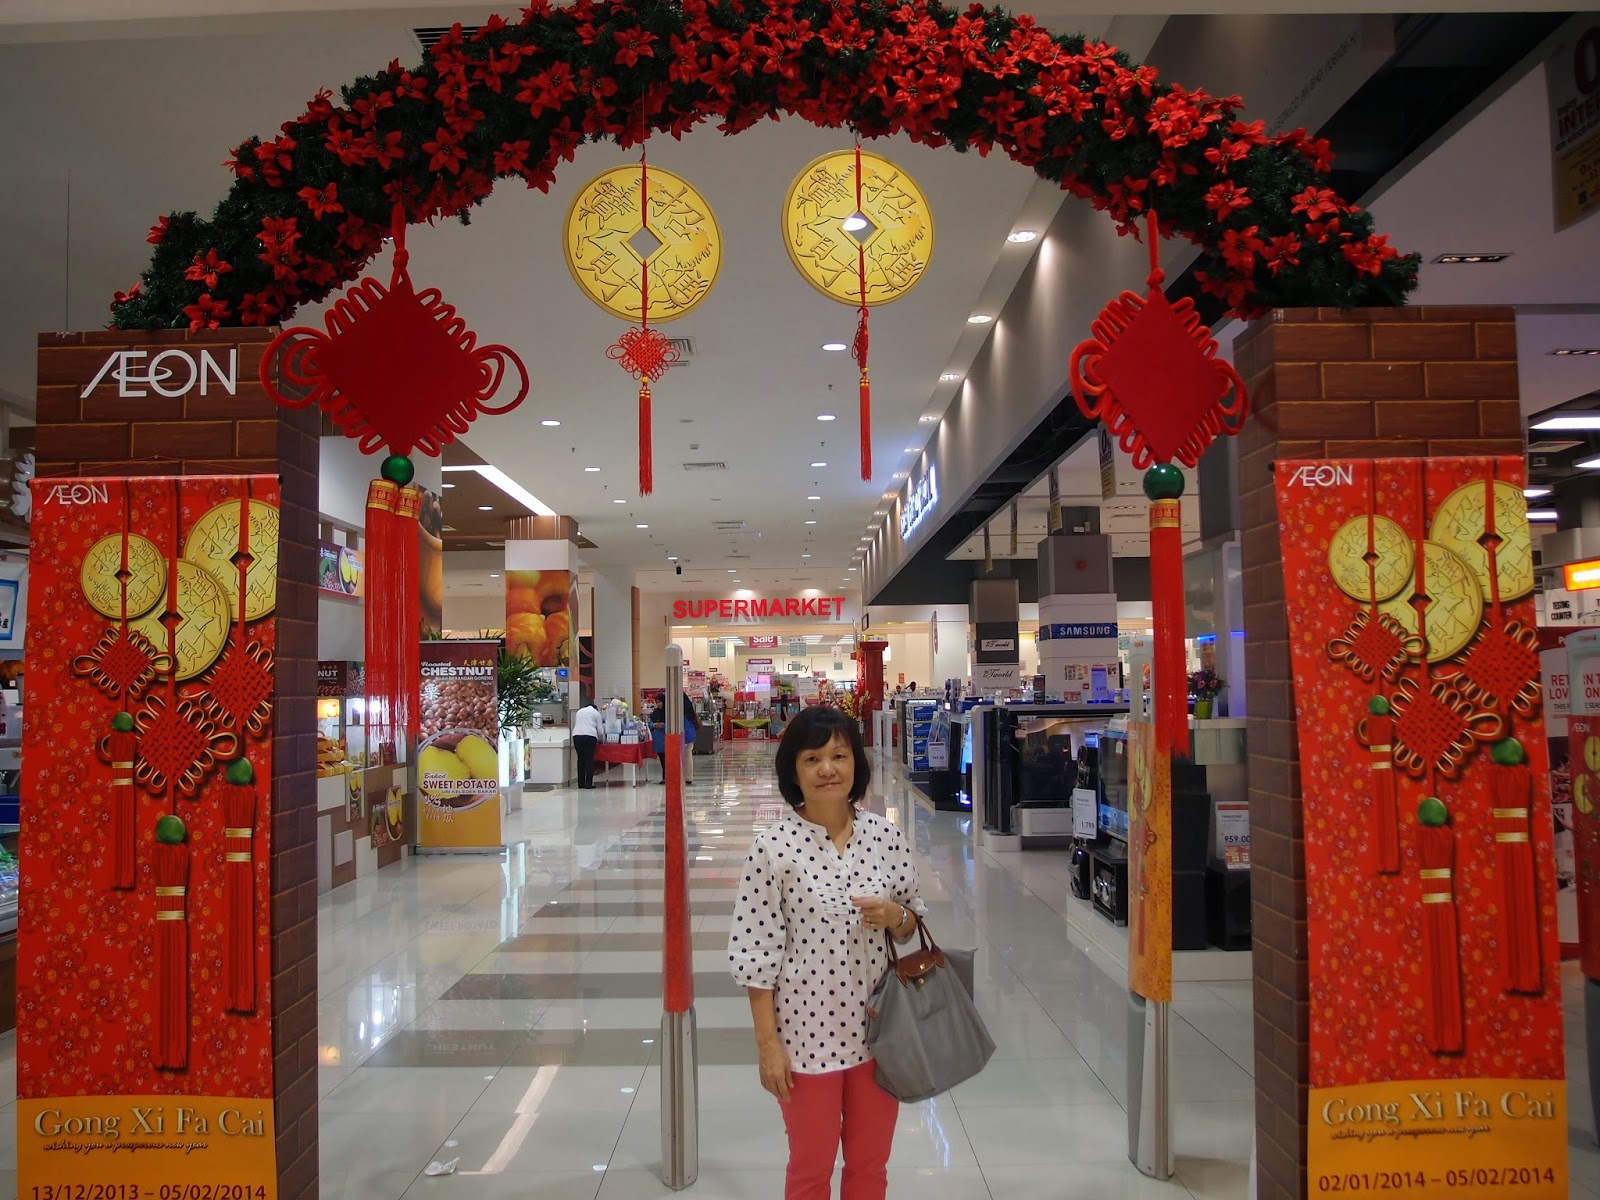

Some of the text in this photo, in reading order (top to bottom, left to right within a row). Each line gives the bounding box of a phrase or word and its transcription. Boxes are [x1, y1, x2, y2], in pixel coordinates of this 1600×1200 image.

[672, 597, 846, 619] SUPERMARKET
[1552, 600, 1570, 609] TESTING
[1551, 611, 1572, 620] COUNTER
[1060, 626, 1111, 636] SAMSUNG
[421, 667, 494, 676] CHESTNUT
[788, 663, 809, 673] Dry
[423, 780, 497, 789] SWEET POTATO
[1322, 1090, 1556, 1126] Gong Xi Fa Cai
[34, 1107, 265, 1140] Gong Xi Fa Cai
[1366, 1130, 1385, 1143] you
[43, 1140, 82, 1153] wishing
[84, 1141, 104, 1154] you
[112, 1141, 163, 1153] prosperous
[164, 1142, 184, 1150] new
[186, 1141, 208, 1154] year
[1319, 1171, 1426, 1192] 02/01/2014
[1446, 1168, 1555, 1187] 05/02/2014
[32, 1184, 138, 1200] 13/12/2013
[159, 1184, 266, 1200] 05/02/2014
